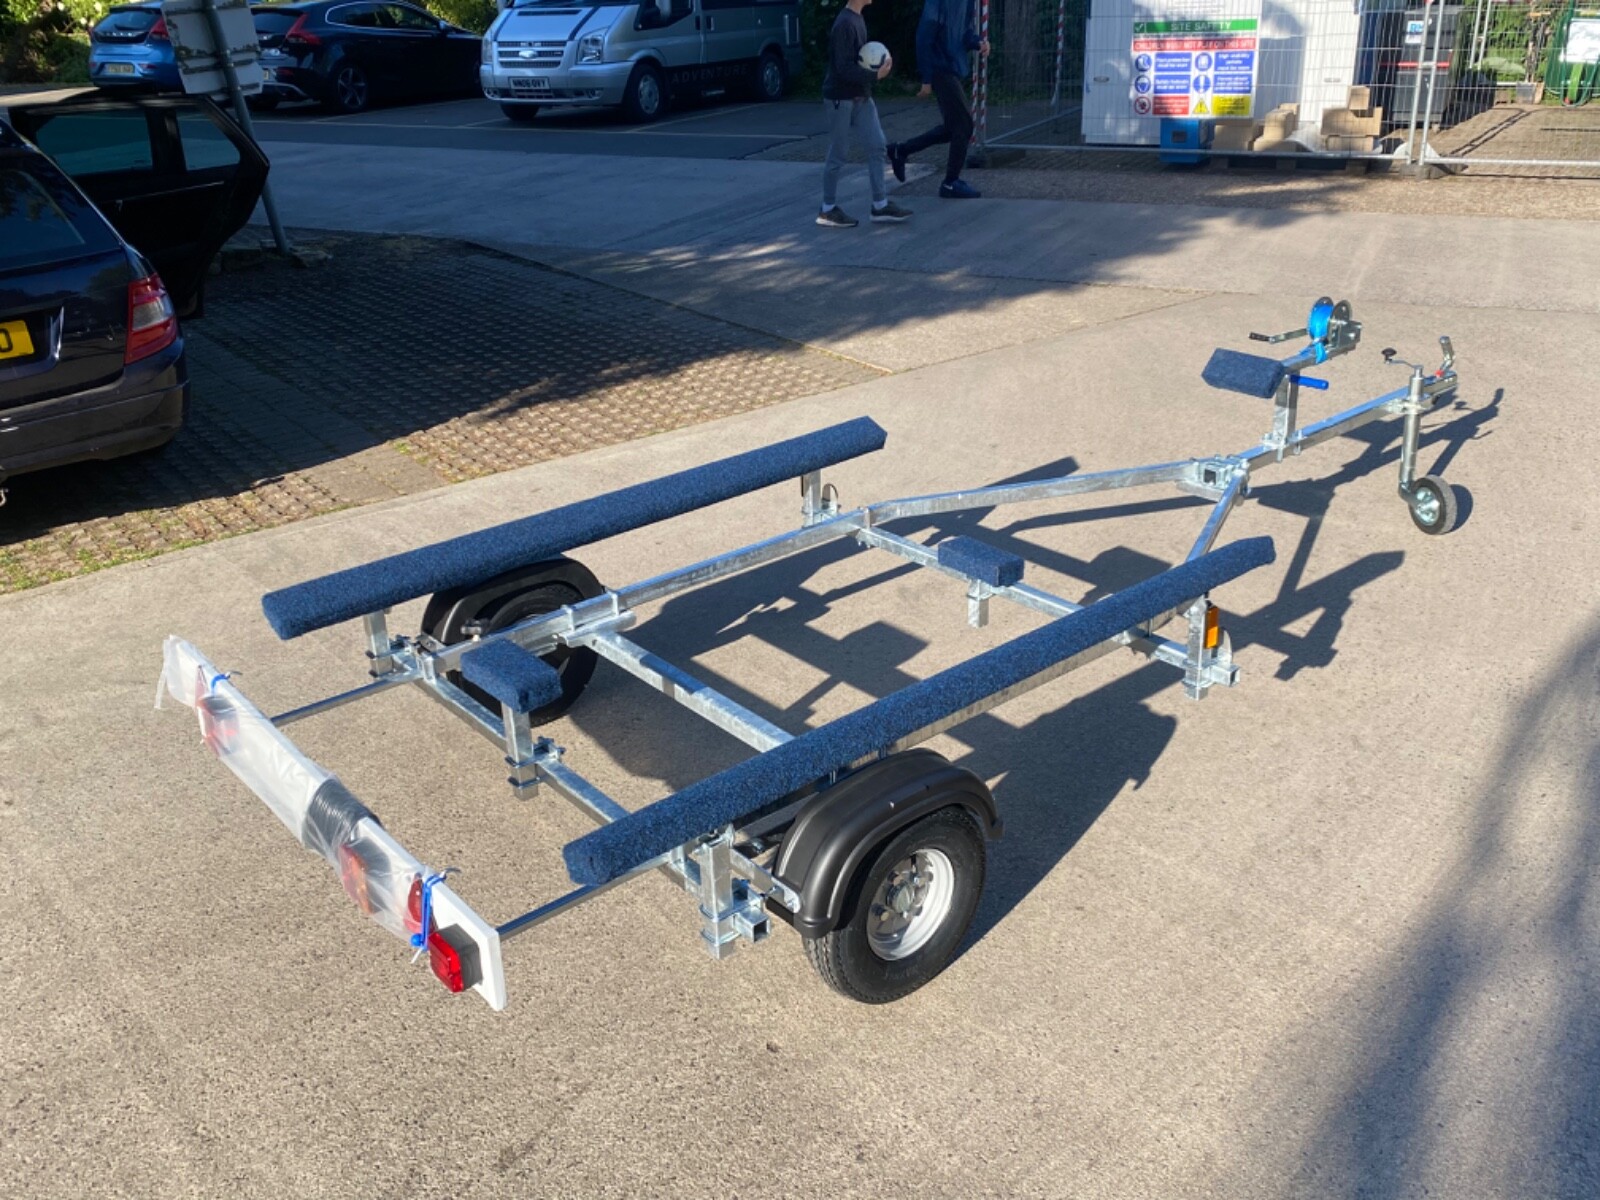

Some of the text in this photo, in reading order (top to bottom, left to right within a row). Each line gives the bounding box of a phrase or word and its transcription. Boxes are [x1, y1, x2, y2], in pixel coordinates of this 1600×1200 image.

[1170, 21, 1231, 31] SITE SAFETY
[671, 63, 748, 84] ADVENTURE
